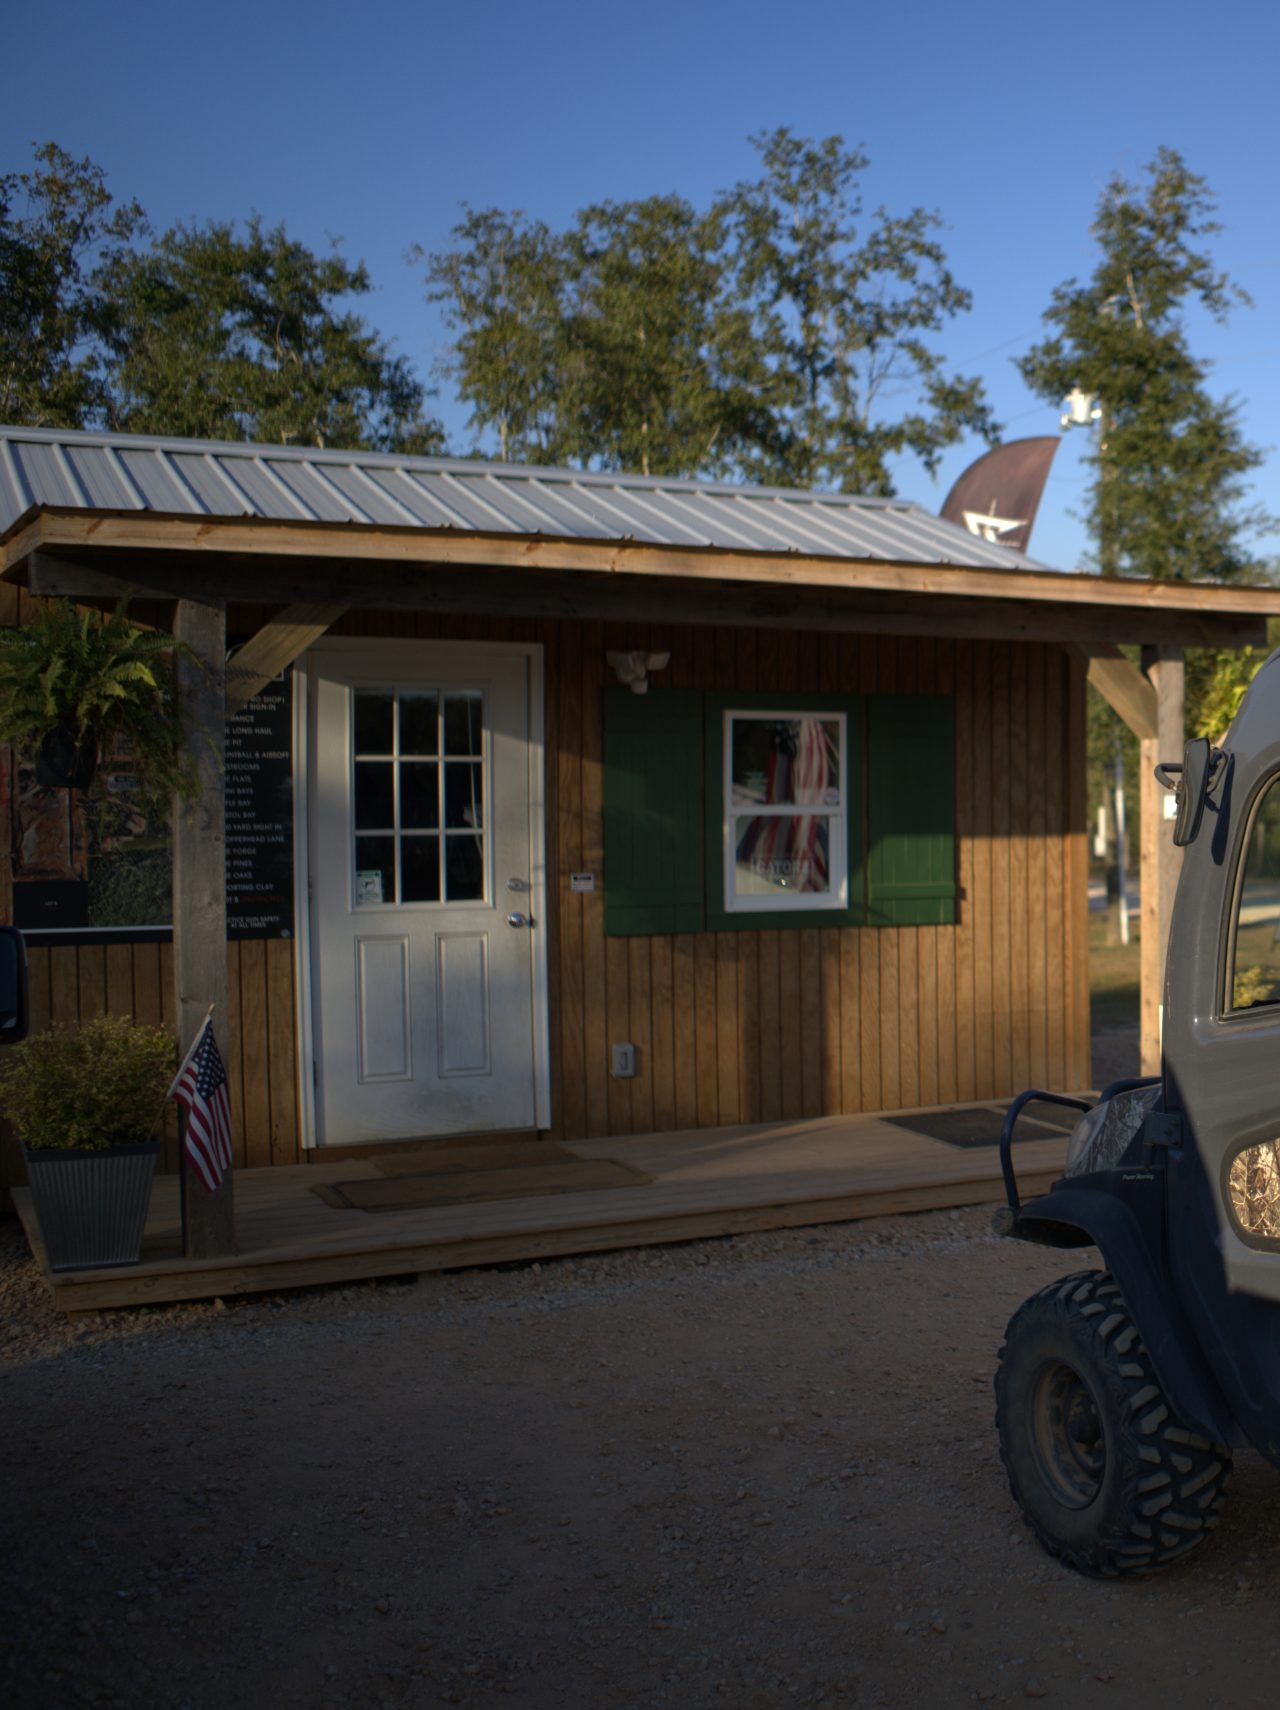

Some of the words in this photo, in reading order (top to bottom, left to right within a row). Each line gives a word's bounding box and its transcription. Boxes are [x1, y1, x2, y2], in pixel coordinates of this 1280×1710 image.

[232, 726, 253, 735] LONG
[261, 751, 289, 759] AIRSOFT
[226, 883, 255, 892] PORTING
[255, 883, 274, 891] CLAY
